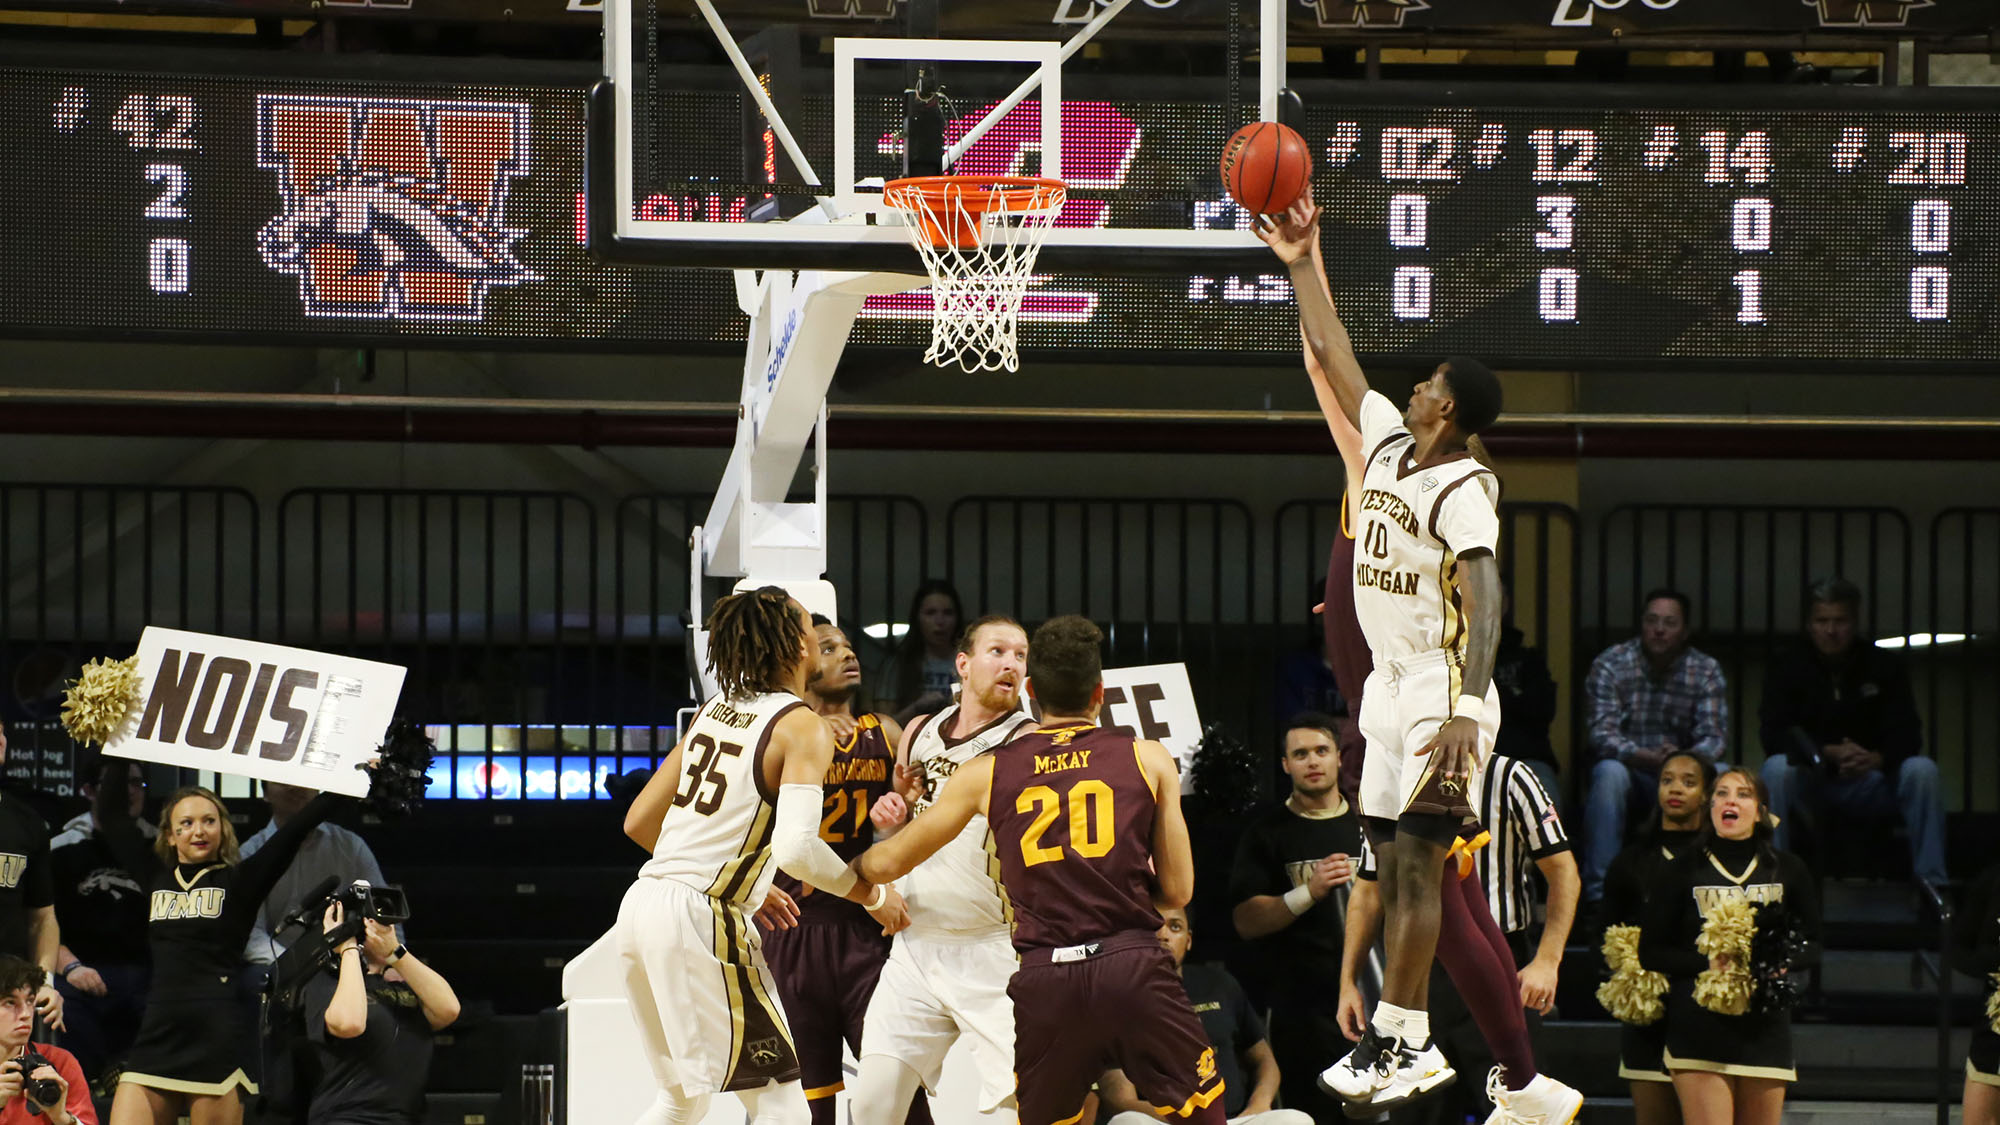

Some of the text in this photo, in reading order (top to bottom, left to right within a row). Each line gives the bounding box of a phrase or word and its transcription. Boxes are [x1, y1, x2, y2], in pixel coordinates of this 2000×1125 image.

[112, 95, 197, 149] 42
[1380, 127, 1457, 181] 02
[1528, 129, 1600, 184] 12
[1700, 131, 1772, 185] 14
[1888, 132, 1967, 185] 20
[144, 164, 187, 219] 2
[1389, 194, 1427, 247] 0
[1535, 195, 1574, 249] 3
[1732, 198, 1771, 251] 0
[1911, 199, 1950, 252] 0
[149, 238, 188, 292] 0
[1393, 266, 1431, 319] 0
[1539, 267, 1577, 321] 0
[1736, 270, 1763, 323] 1
[1910, 266, 1949, 319] 0
[1364, 519, 1388, 560] 10
[706, 702, 758, 729] JOHNSON
[672, 733, 744, 817] 35
[1033, 750, 1092, 775] McKAY
[818, 788, 868, 843] 21
[1015, 779, 1115, 868] 20
[149, 887, 226, 922] WMU
